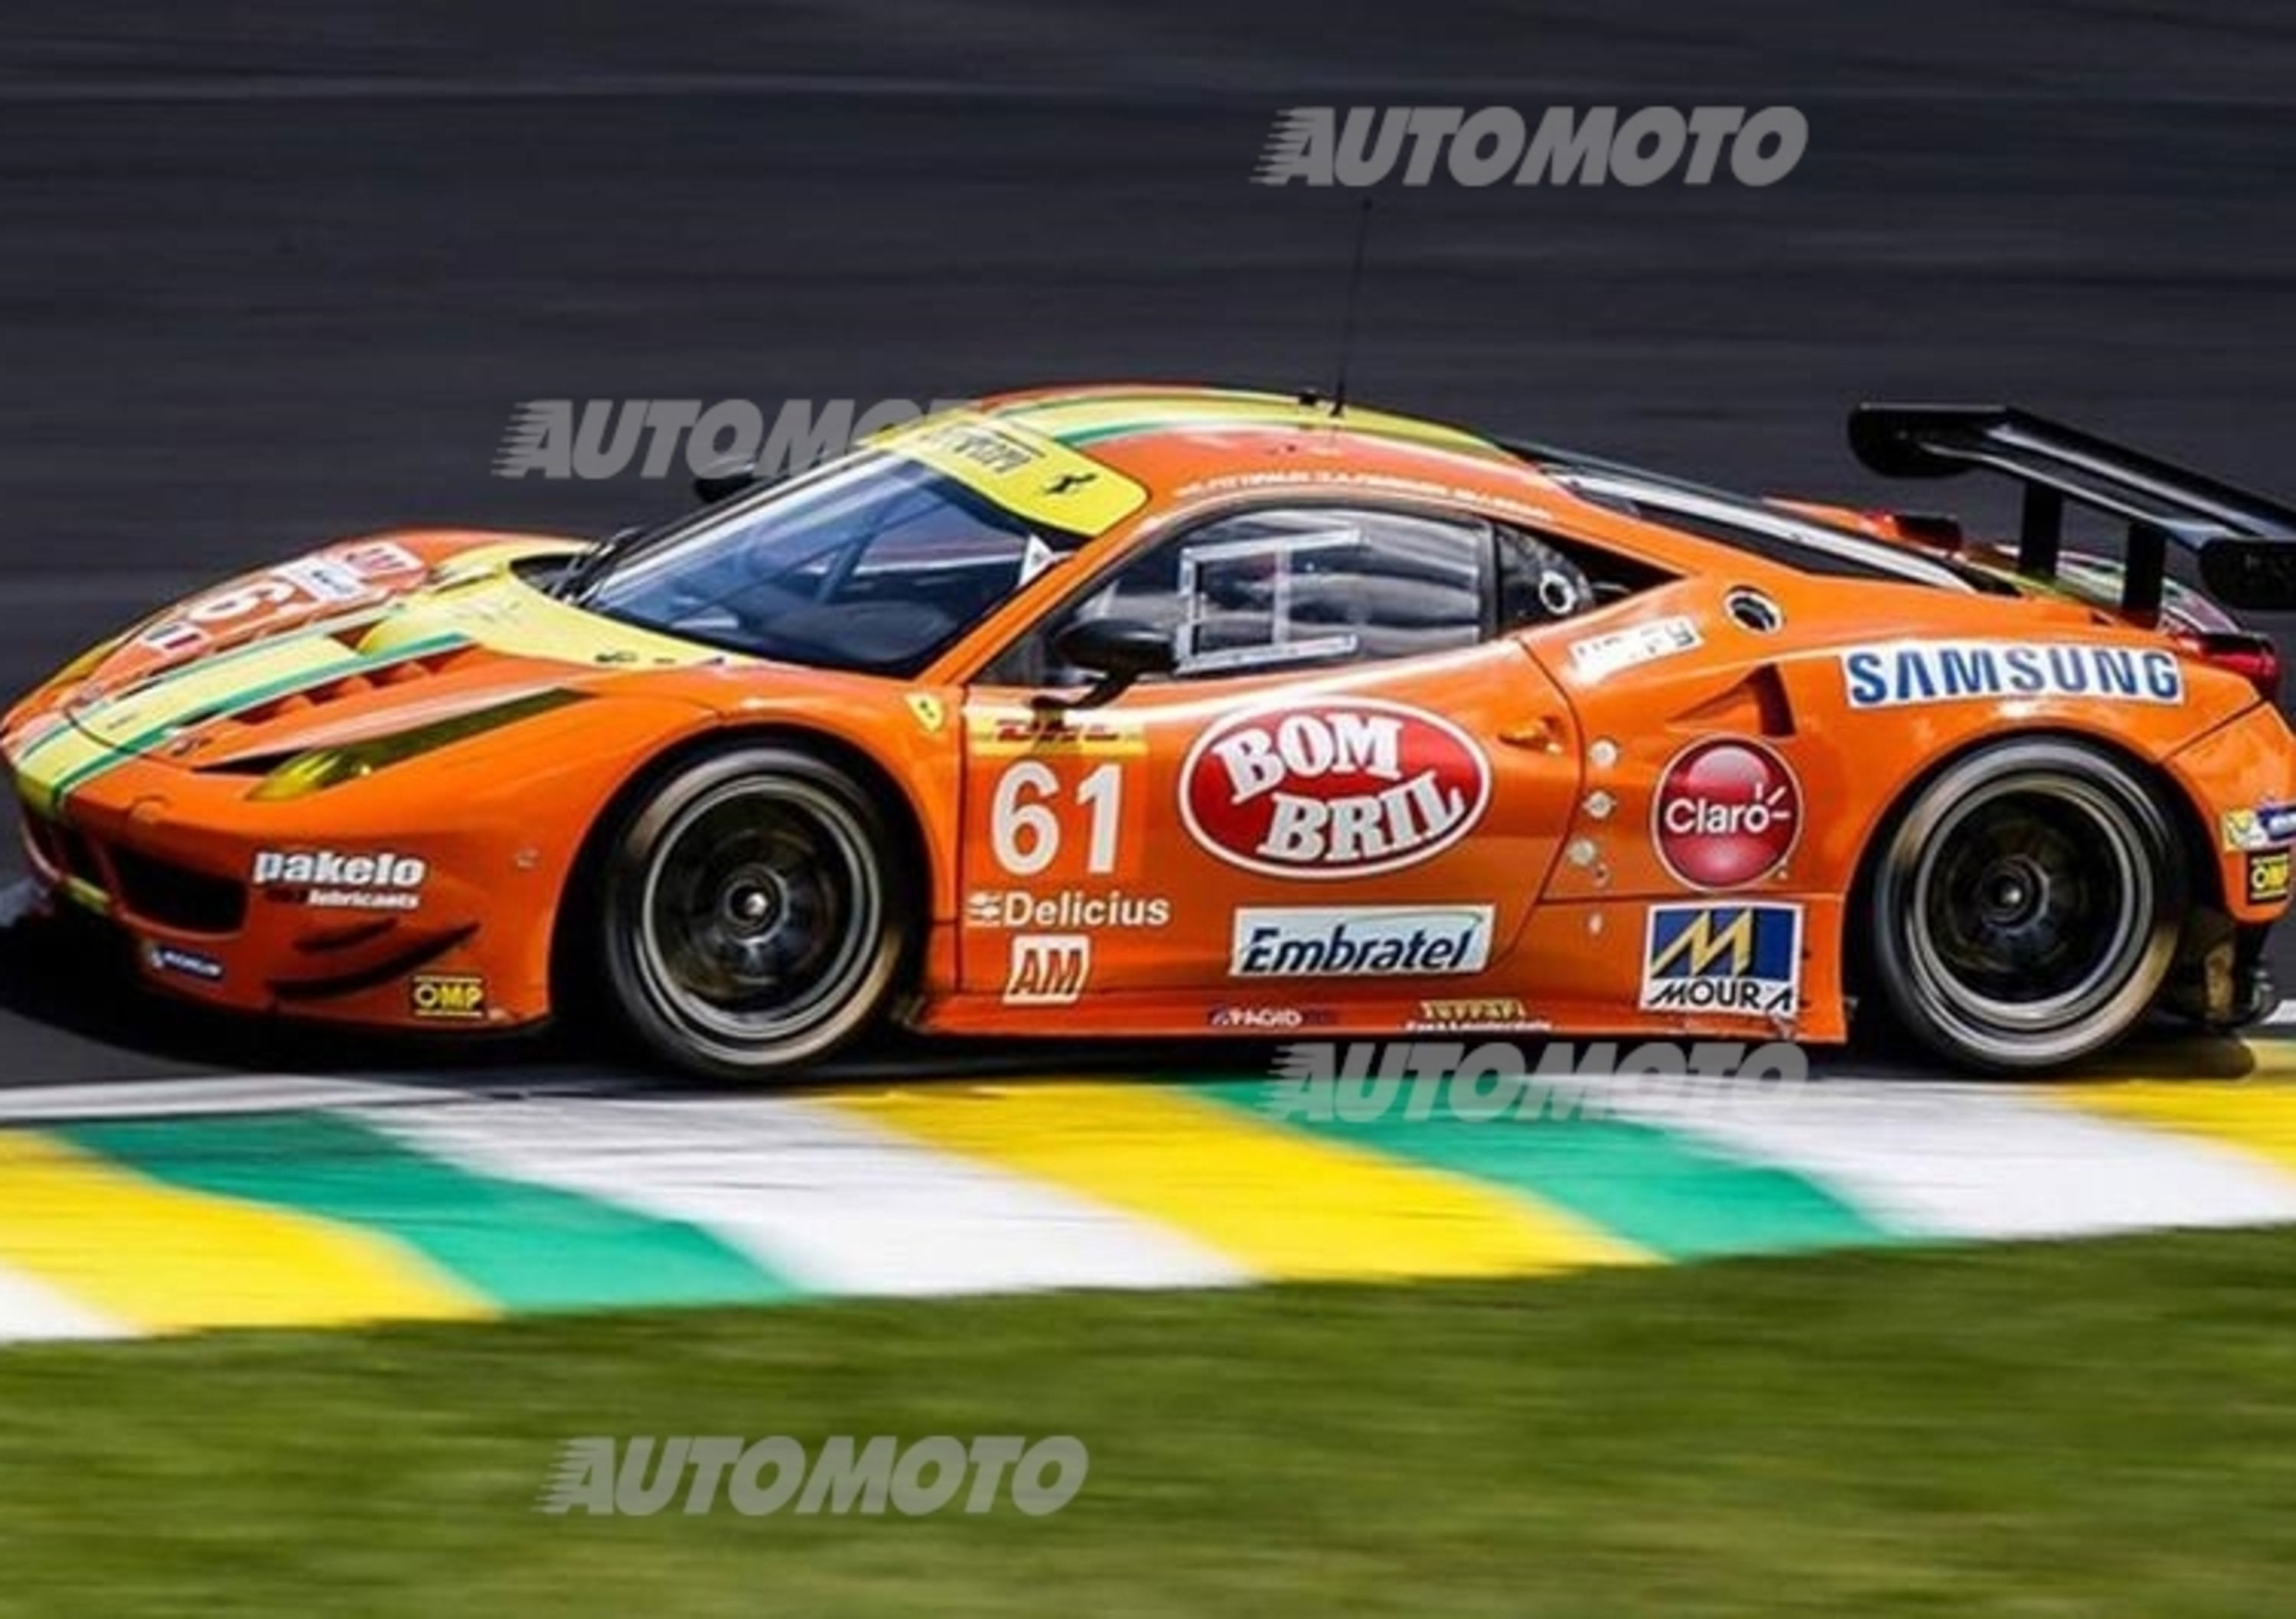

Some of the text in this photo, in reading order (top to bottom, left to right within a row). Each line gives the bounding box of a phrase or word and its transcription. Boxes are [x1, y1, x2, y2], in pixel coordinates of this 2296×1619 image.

[1847, 647, 2180, 704] SAMSUNG
[1211, 712, 1404, 805] BOM
[991, 760, 1122, 875] 61
[1255, 770, 1466, 862] BRIL
[1665, 797, 1769, 833] Claro
[253, 852, 426, 887] pakelo
[1003, 891, 1171, 927] Delicius
[1241, 923, 1474, 973] Embratel
[414, 983, 484, 1009] OMP
[1009, 949, 1083, 996] AM
[1649, 979, 1794, 1011] MOURA
